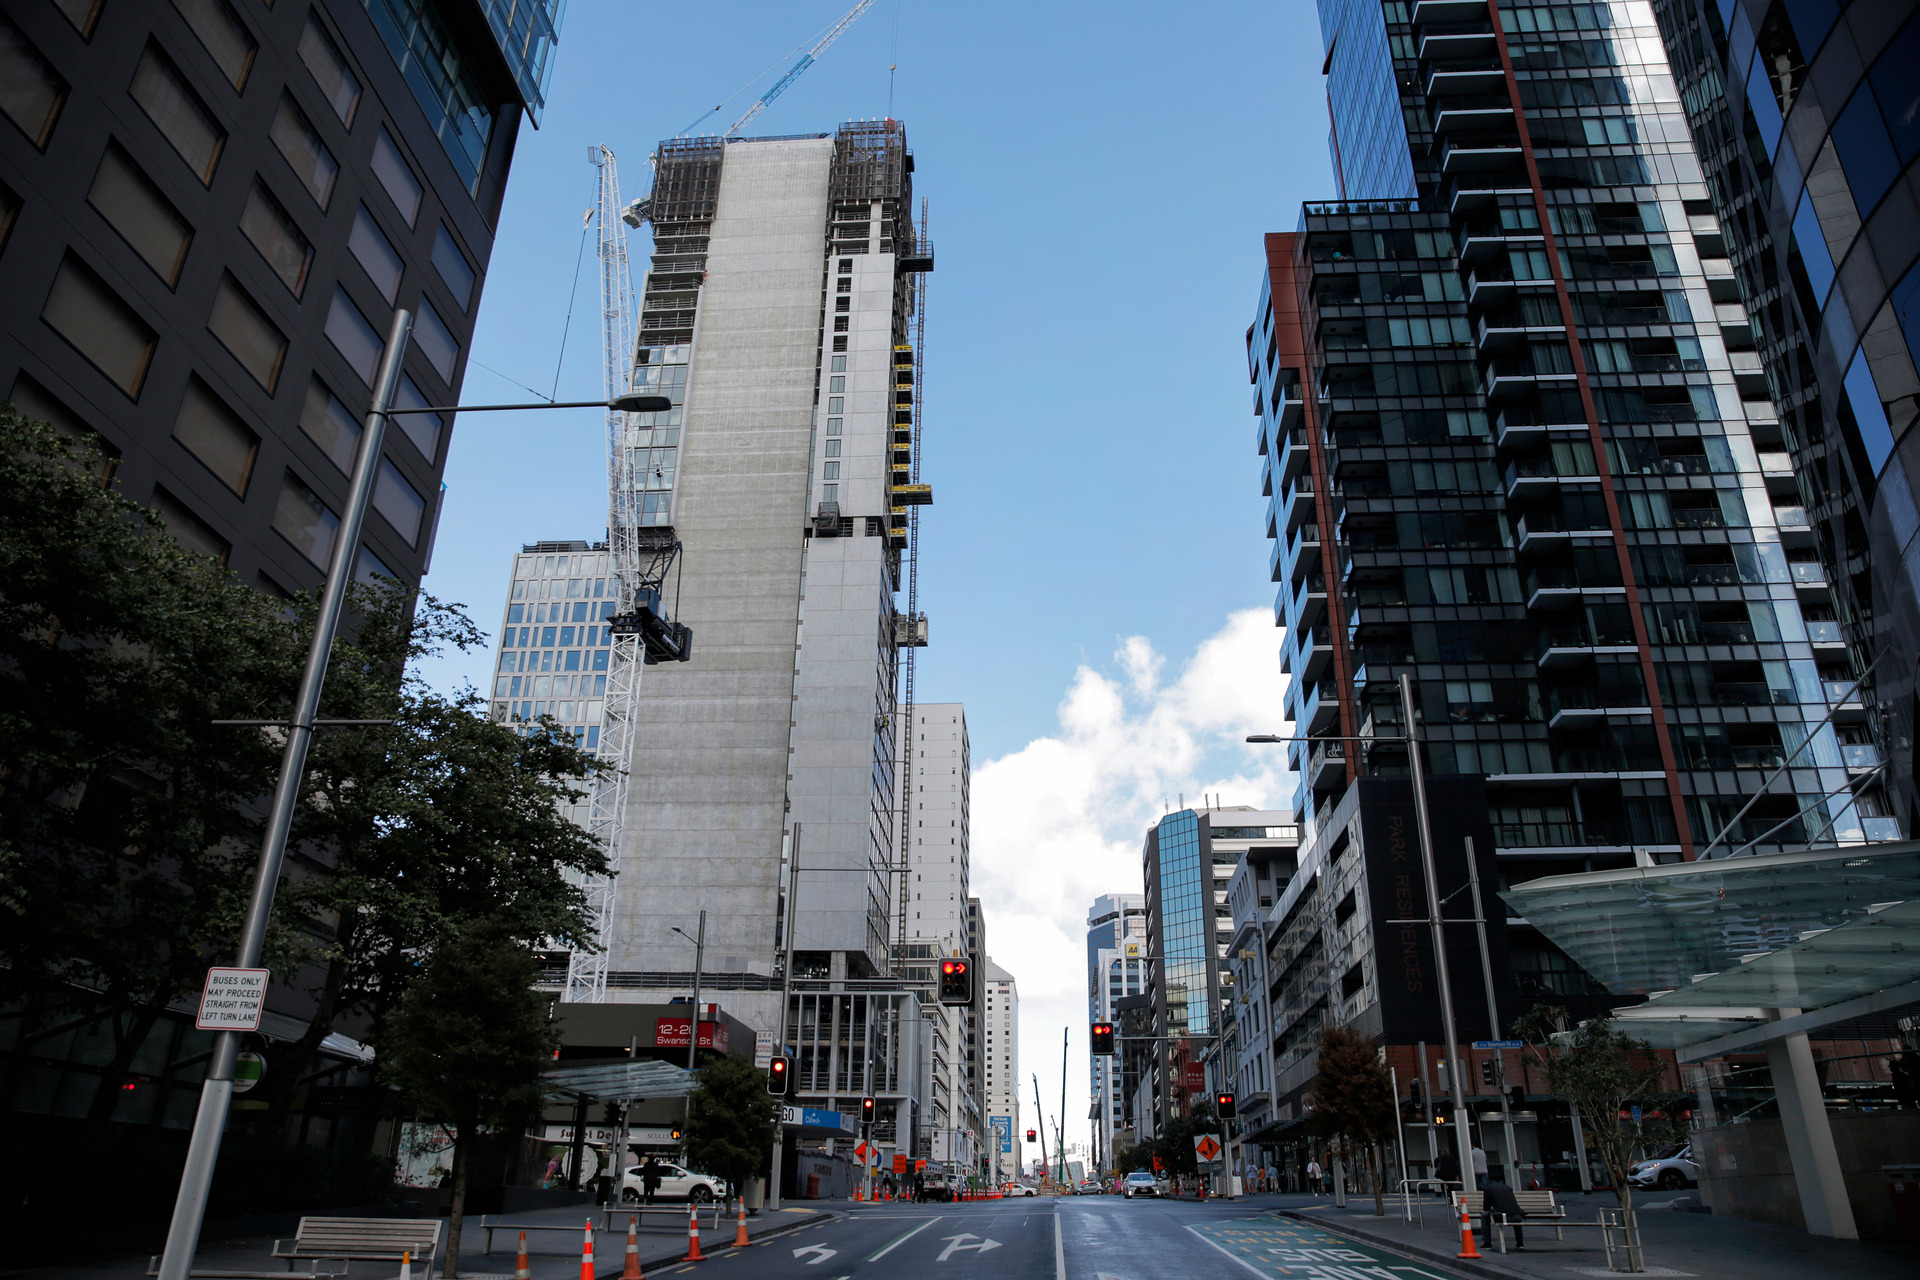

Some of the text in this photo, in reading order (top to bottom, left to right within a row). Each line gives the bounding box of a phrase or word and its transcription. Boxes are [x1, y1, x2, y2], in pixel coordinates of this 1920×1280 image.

[1388, 816, 1423, 993] PARK RESIDENCES
[1128, 946, 1138, 954] AA
[213, 976, 261, 986] BUSES ONLY
[207, 988, 261, 998] MAY PROCEED
[205, 1000, 259, 1010] STRAIGHT FROM
[201, 1012, 257, 1022] LEFT TURN LANE
[699, 1036, 711, 1045] St
[1267, 1249, 1380, 1262] BUS
[1285, 1265, 1450, 1280] LANE
